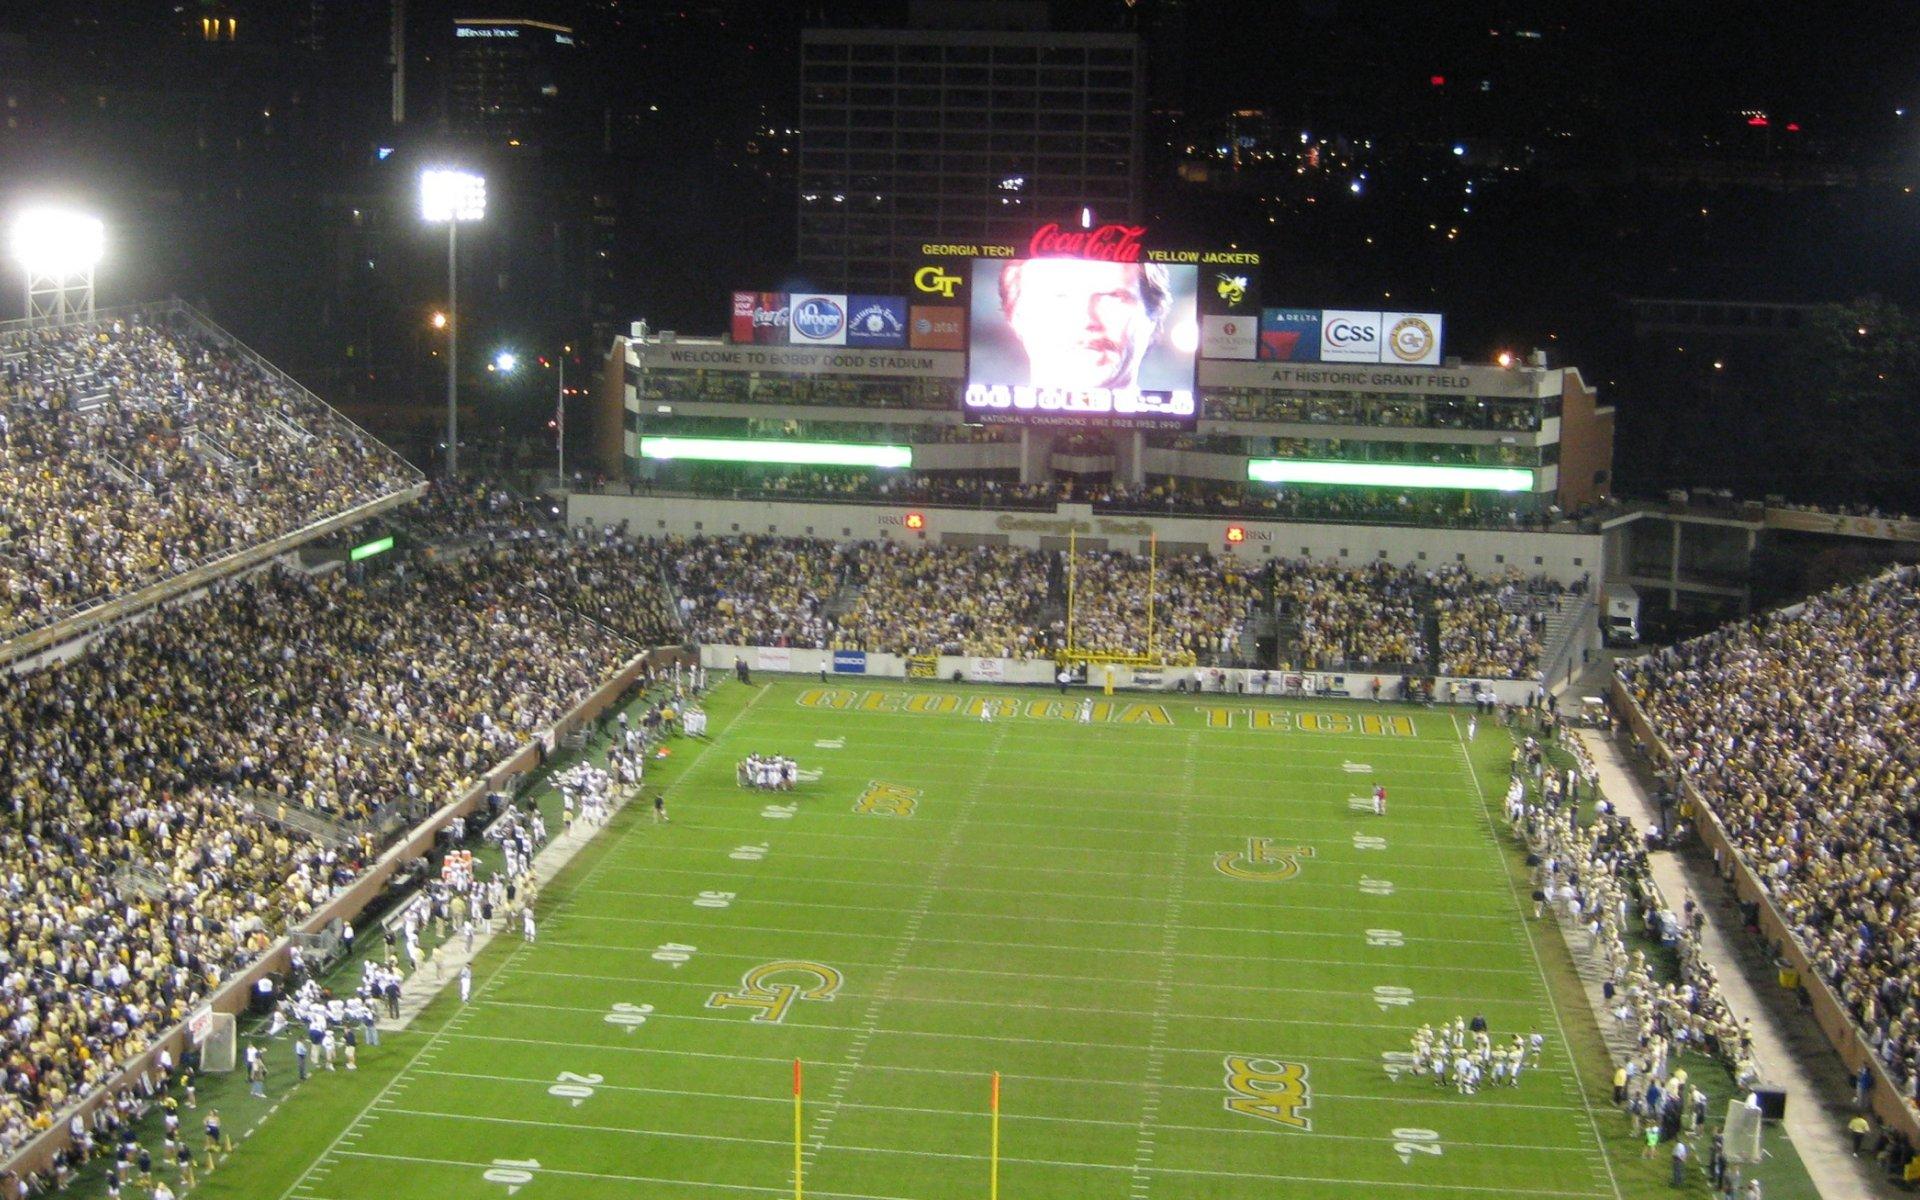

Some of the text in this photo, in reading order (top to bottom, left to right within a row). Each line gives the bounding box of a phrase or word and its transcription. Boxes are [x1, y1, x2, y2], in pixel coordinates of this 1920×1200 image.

[922, 244, 1015, 257] GEORGIA TECH
[1147, 250, 1260, 265] YELLOW JACKETS
[914, 266, 962, 298] GT
[800, 303, 840, 335] Kroger
[1286, 314, 1318, 323] DELTA
[1334, 324, 1376, 342] CSS
[671, 352, 933, 369] WELCOME TO BOBBY DODD STADIUM
[1272, 370, 1471, 389] AT HISTORIC GRANT FIELD
[980, 414, 1024, 424] NATIONAL
[1031, 416, 1086, 426] CHAMPIONS
[796, 689, 1418, 737] GEORGIA TECH
[1365, 929, 1405, 947] 50
[651, 942, 698, 963] 40
[704, 960, 844, 1024] GT
[1372, 985, 1415, 1006] 40
[604, 1002, 655, 1026] 30
[547, 1070, 604, 1098] 20
[1223, 1055, 1312, 1131] ACC
[1391, 1127, 1443, 1155] 20
[482, 1157, 541, 1184] 10
